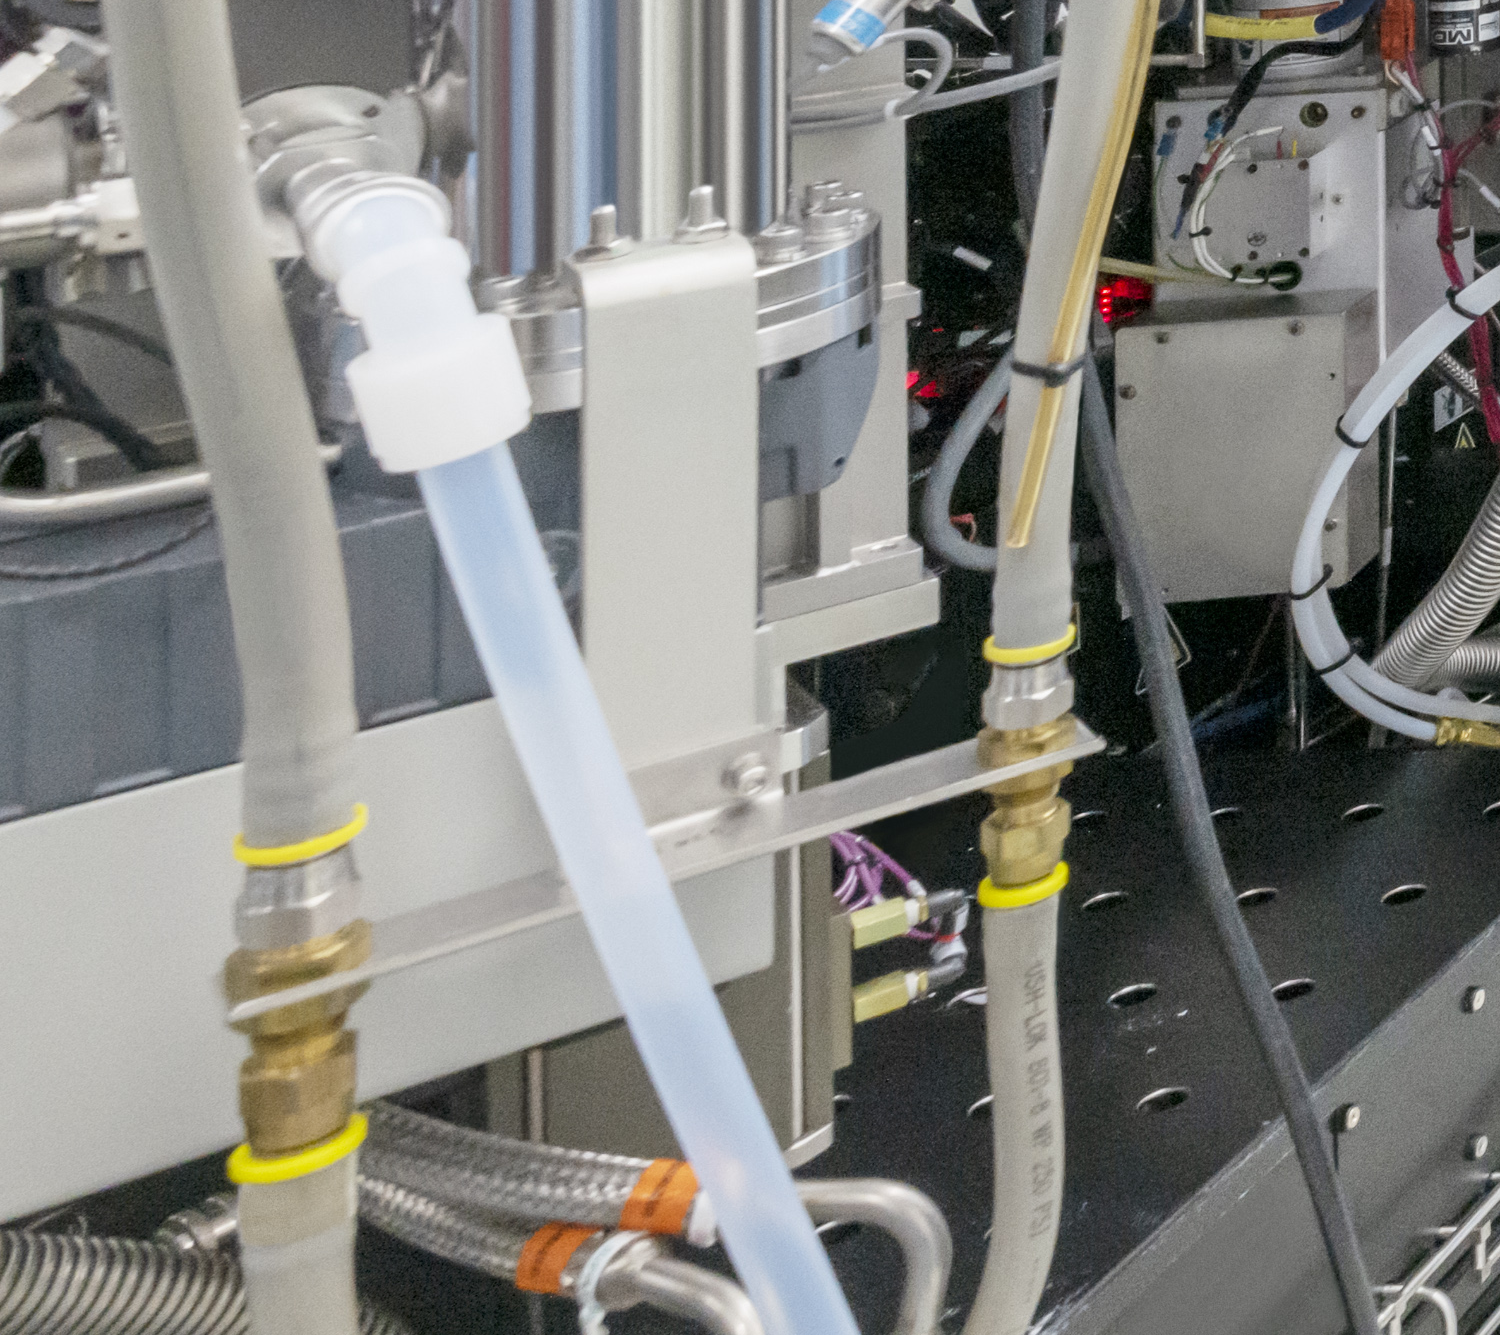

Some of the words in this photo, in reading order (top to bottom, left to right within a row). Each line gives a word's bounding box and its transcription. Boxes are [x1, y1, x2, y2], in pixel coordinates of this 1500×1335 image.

[1022, 961, 1049, 1051] USH-LOK
[1031, 1157, 1055, 1195] 250
[1029, 1204, 1054, 1239] PSI
